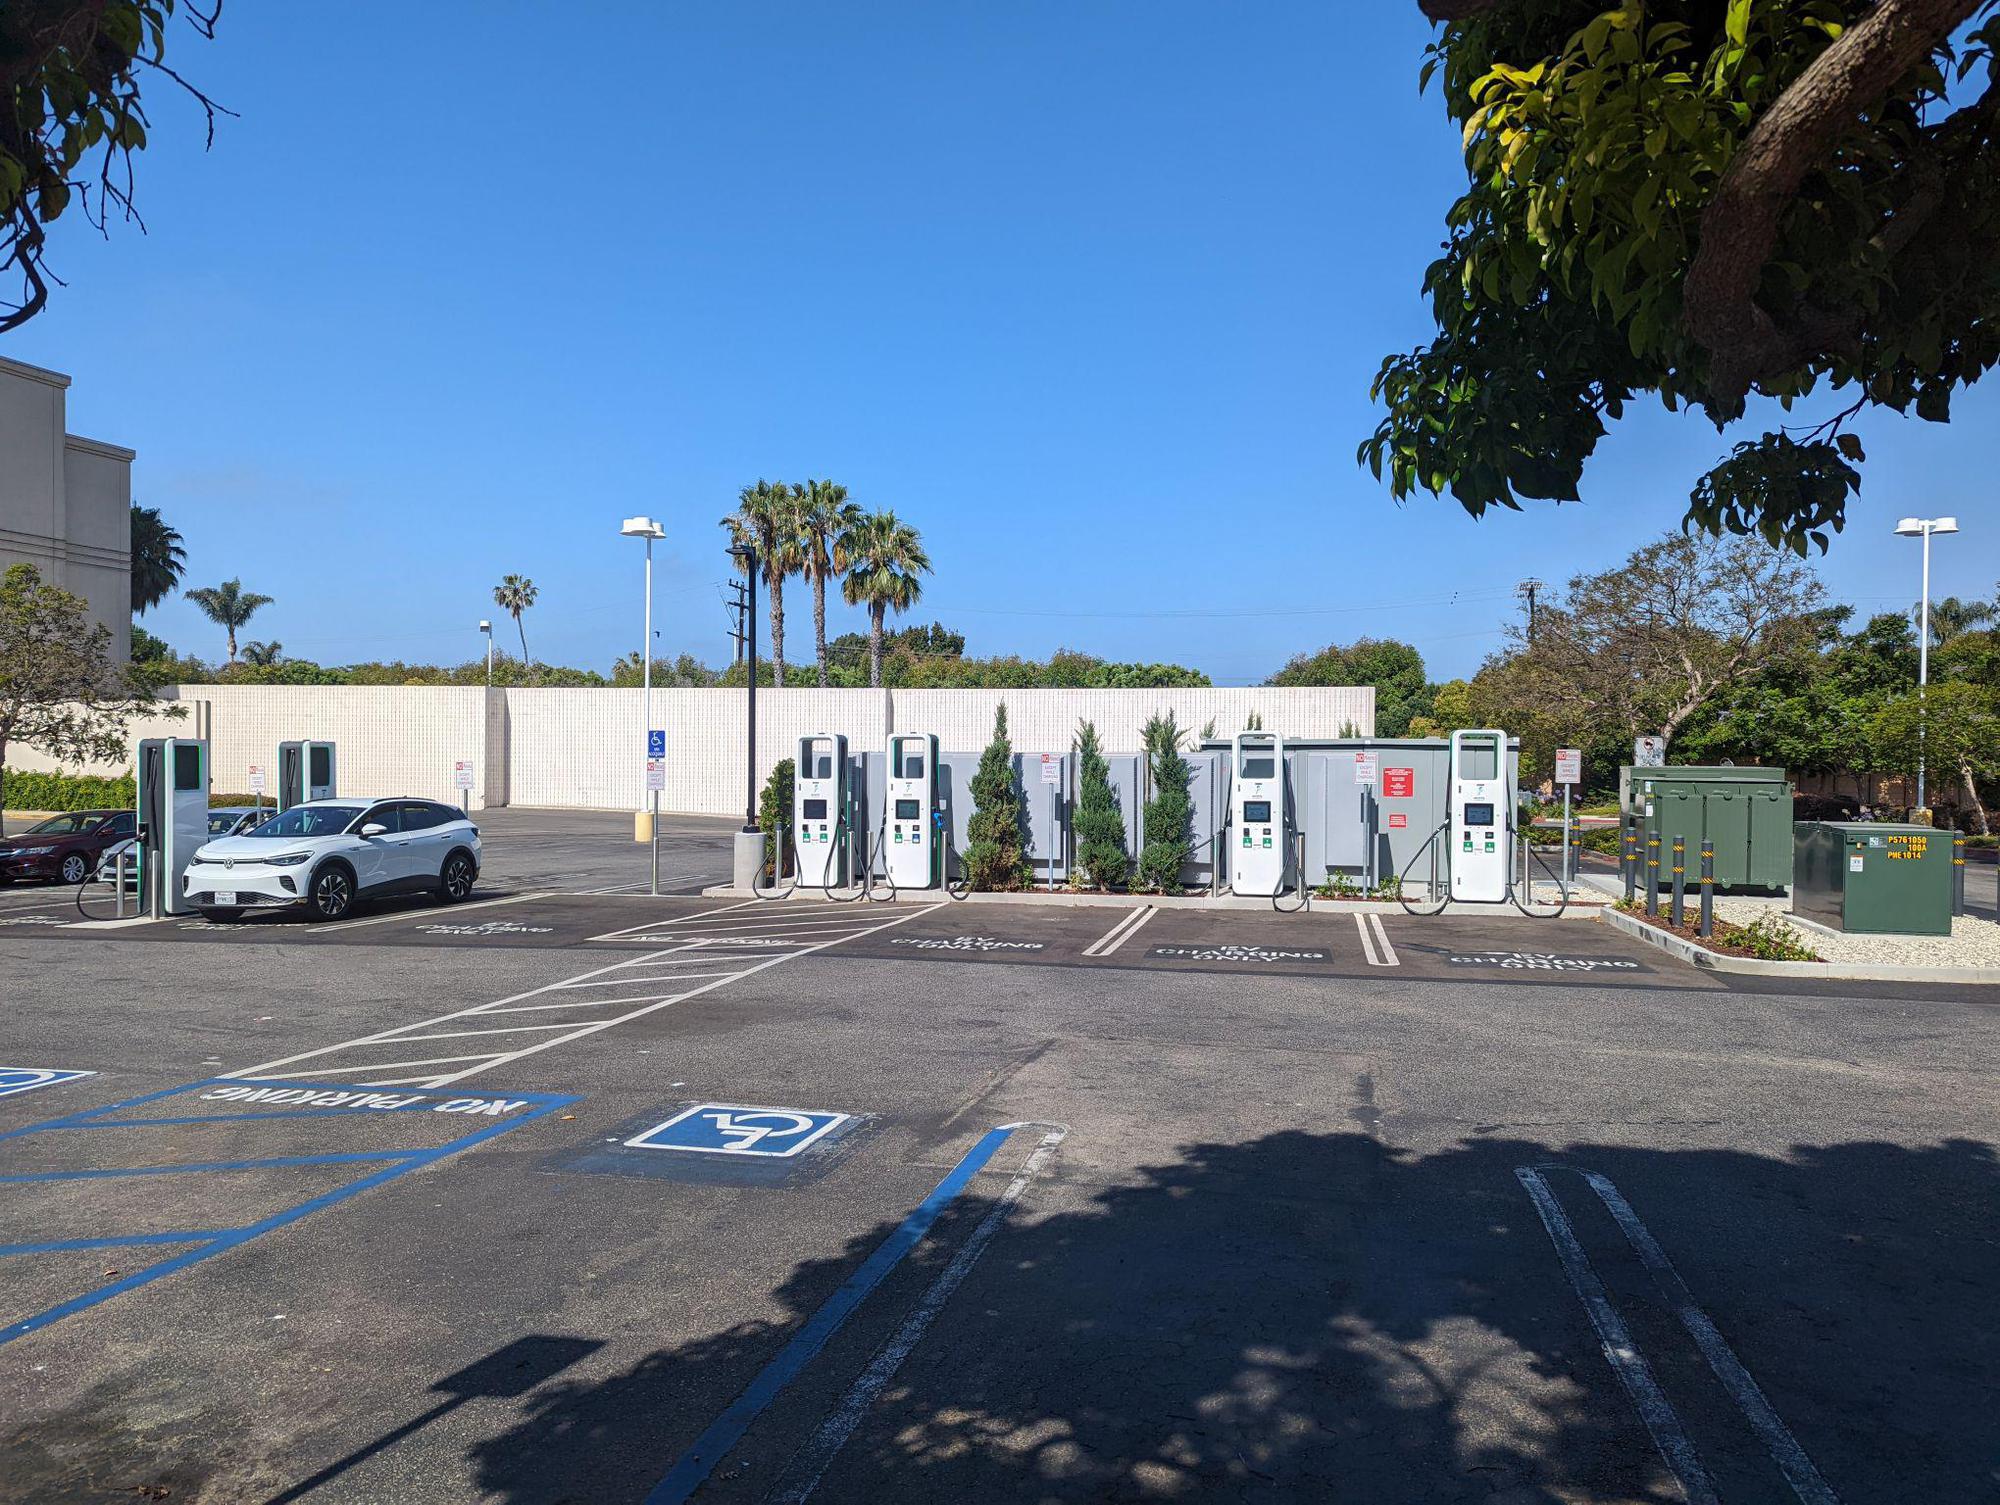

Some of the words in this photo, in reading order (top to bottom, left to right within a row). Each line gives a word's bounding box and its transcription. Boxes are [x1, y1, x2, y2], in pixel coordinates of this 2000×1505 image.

[1156, 949, 1324, 959] CHARGING
[1193, 954, 1280, 962] ONLY
[1450, 957, 1639, 968] CHARGING
[1500, 962, 1595, 971] ONLY
[201, 1087, 427, 1109] PARKING
[433, 1098, 528, 1115] NO
